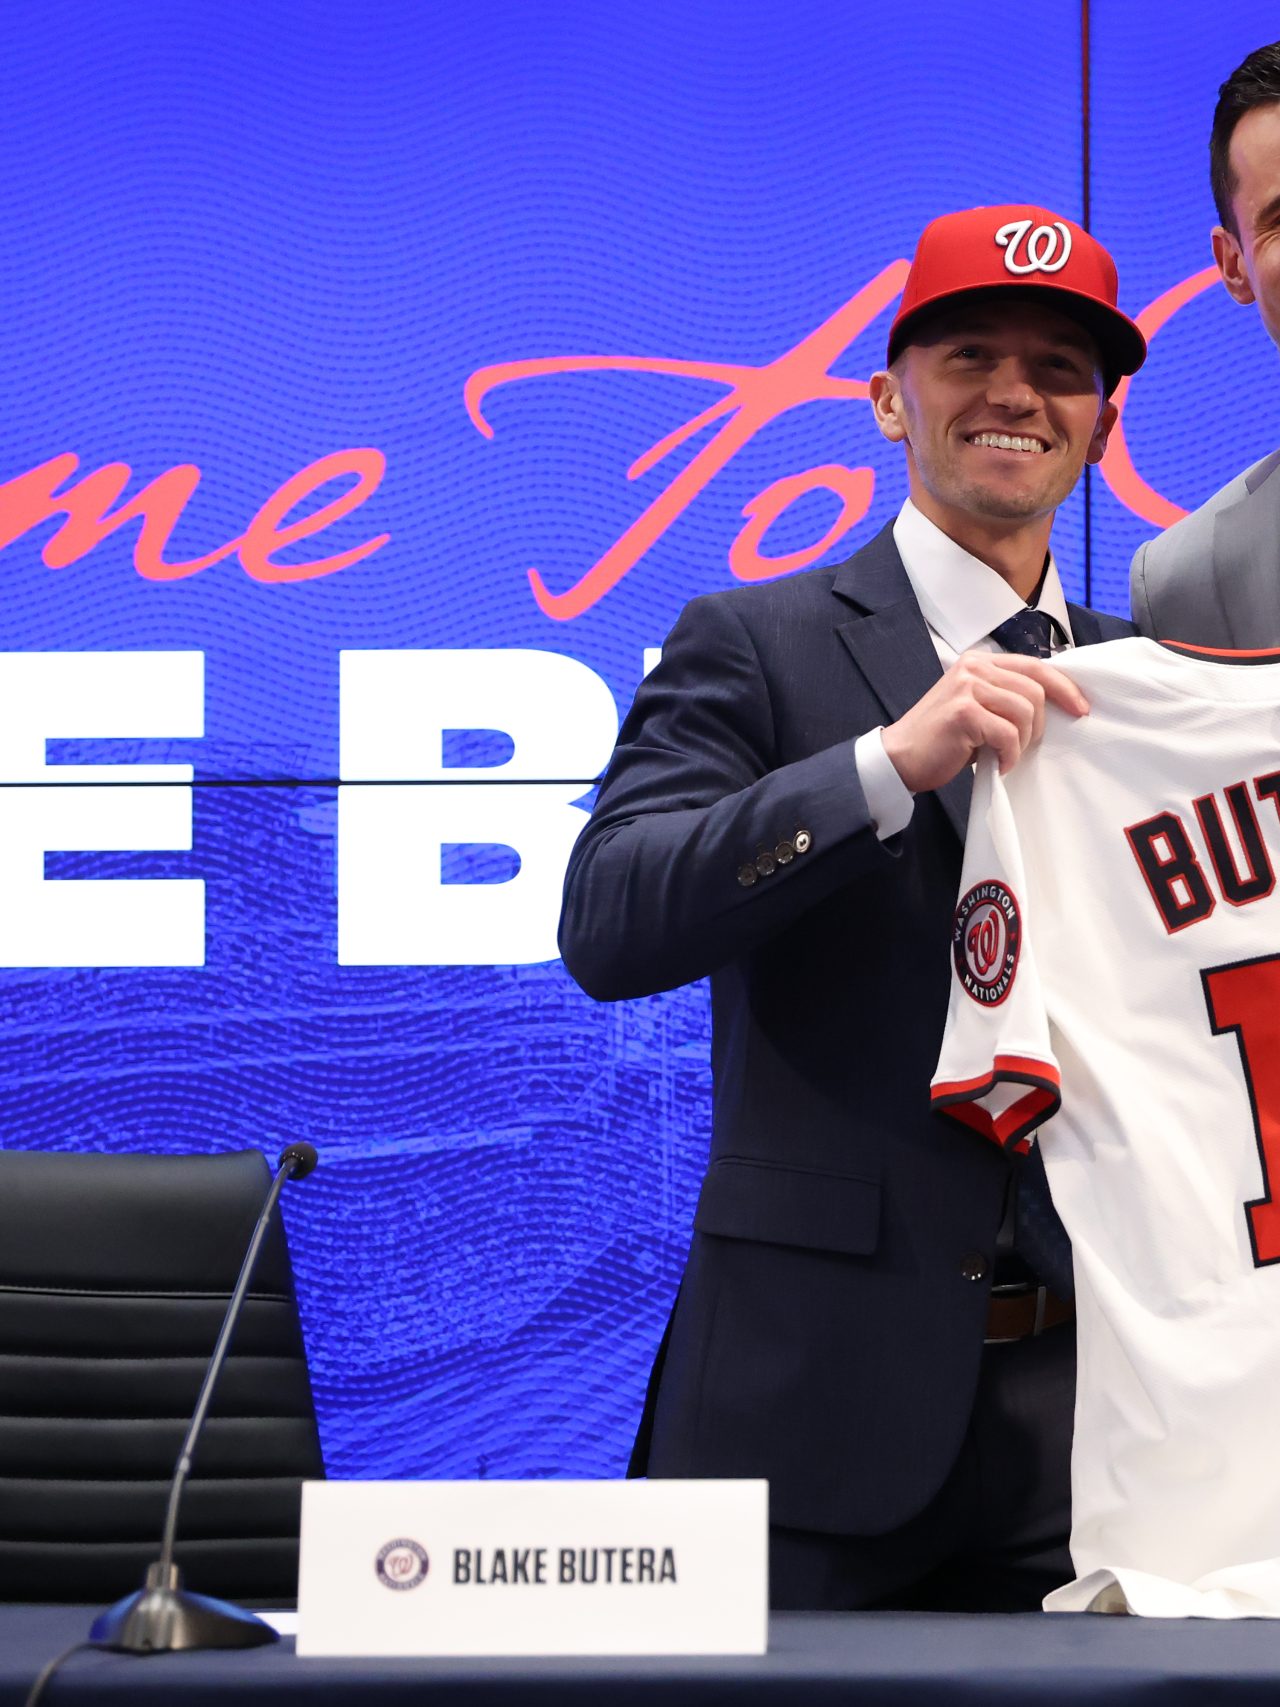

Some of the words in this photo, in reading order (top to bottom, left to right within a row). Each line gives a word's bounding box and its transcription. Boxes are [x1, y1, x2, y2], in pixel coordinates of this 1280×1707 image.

[995, 219, 1072, 275] W
[954, 885, 1016, 942] WASHINGTON
[964, 953, 1015, 1001] NATIONALS
[453, 1548, 547, 1584] BLAKE
[558, 1547, 677, 1584] BUTERA
